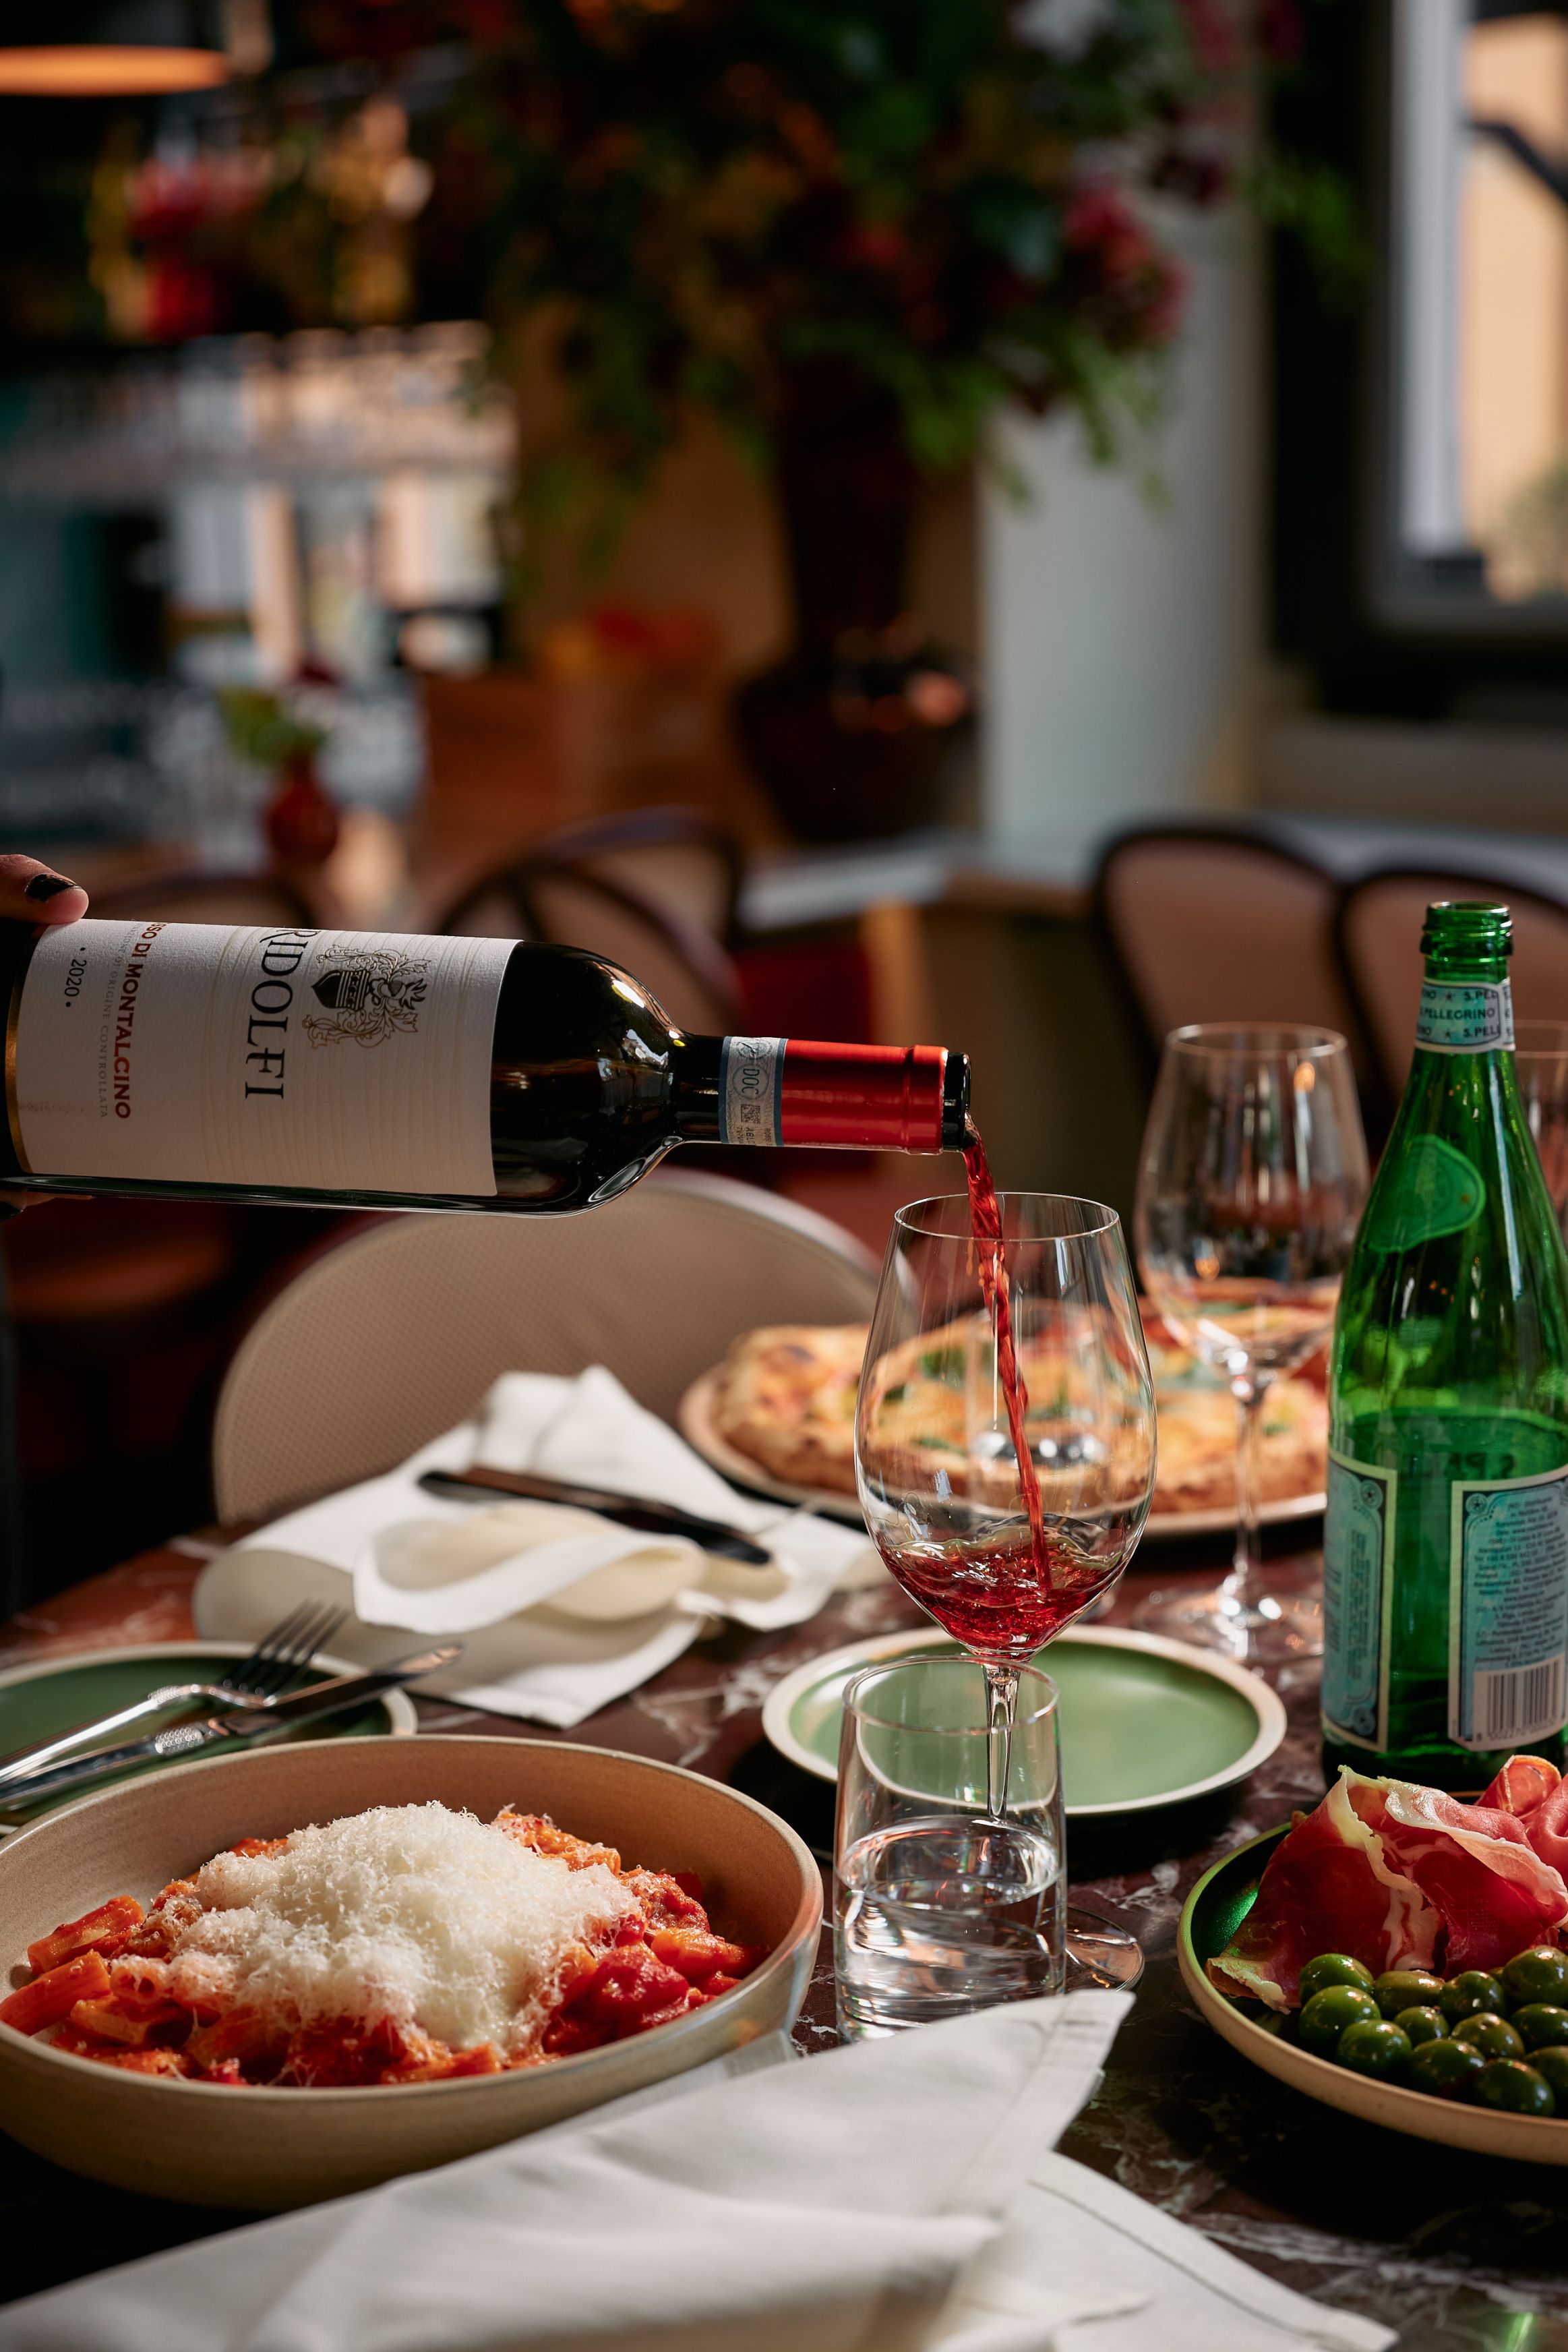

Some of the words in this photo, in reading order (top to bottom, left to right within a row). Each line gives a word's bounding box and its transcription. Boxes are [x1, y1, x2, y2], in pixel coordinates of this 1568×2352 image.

[131, 942, 152, 958] DI
[141, 922, 170, 939] SSO
[64, 958, 88, 997] 2020
[113, 956, 123, 967] DI
[102, 970, 119, 1020] ORIGINE
[245, 929, 322, 1099] RIDOLFI
[113, 963, 144, 1119] MONTALCINO
[98, 1025, 109, 1118] CONTROLLATA
[741, 1068, 760, 1095] DOC
